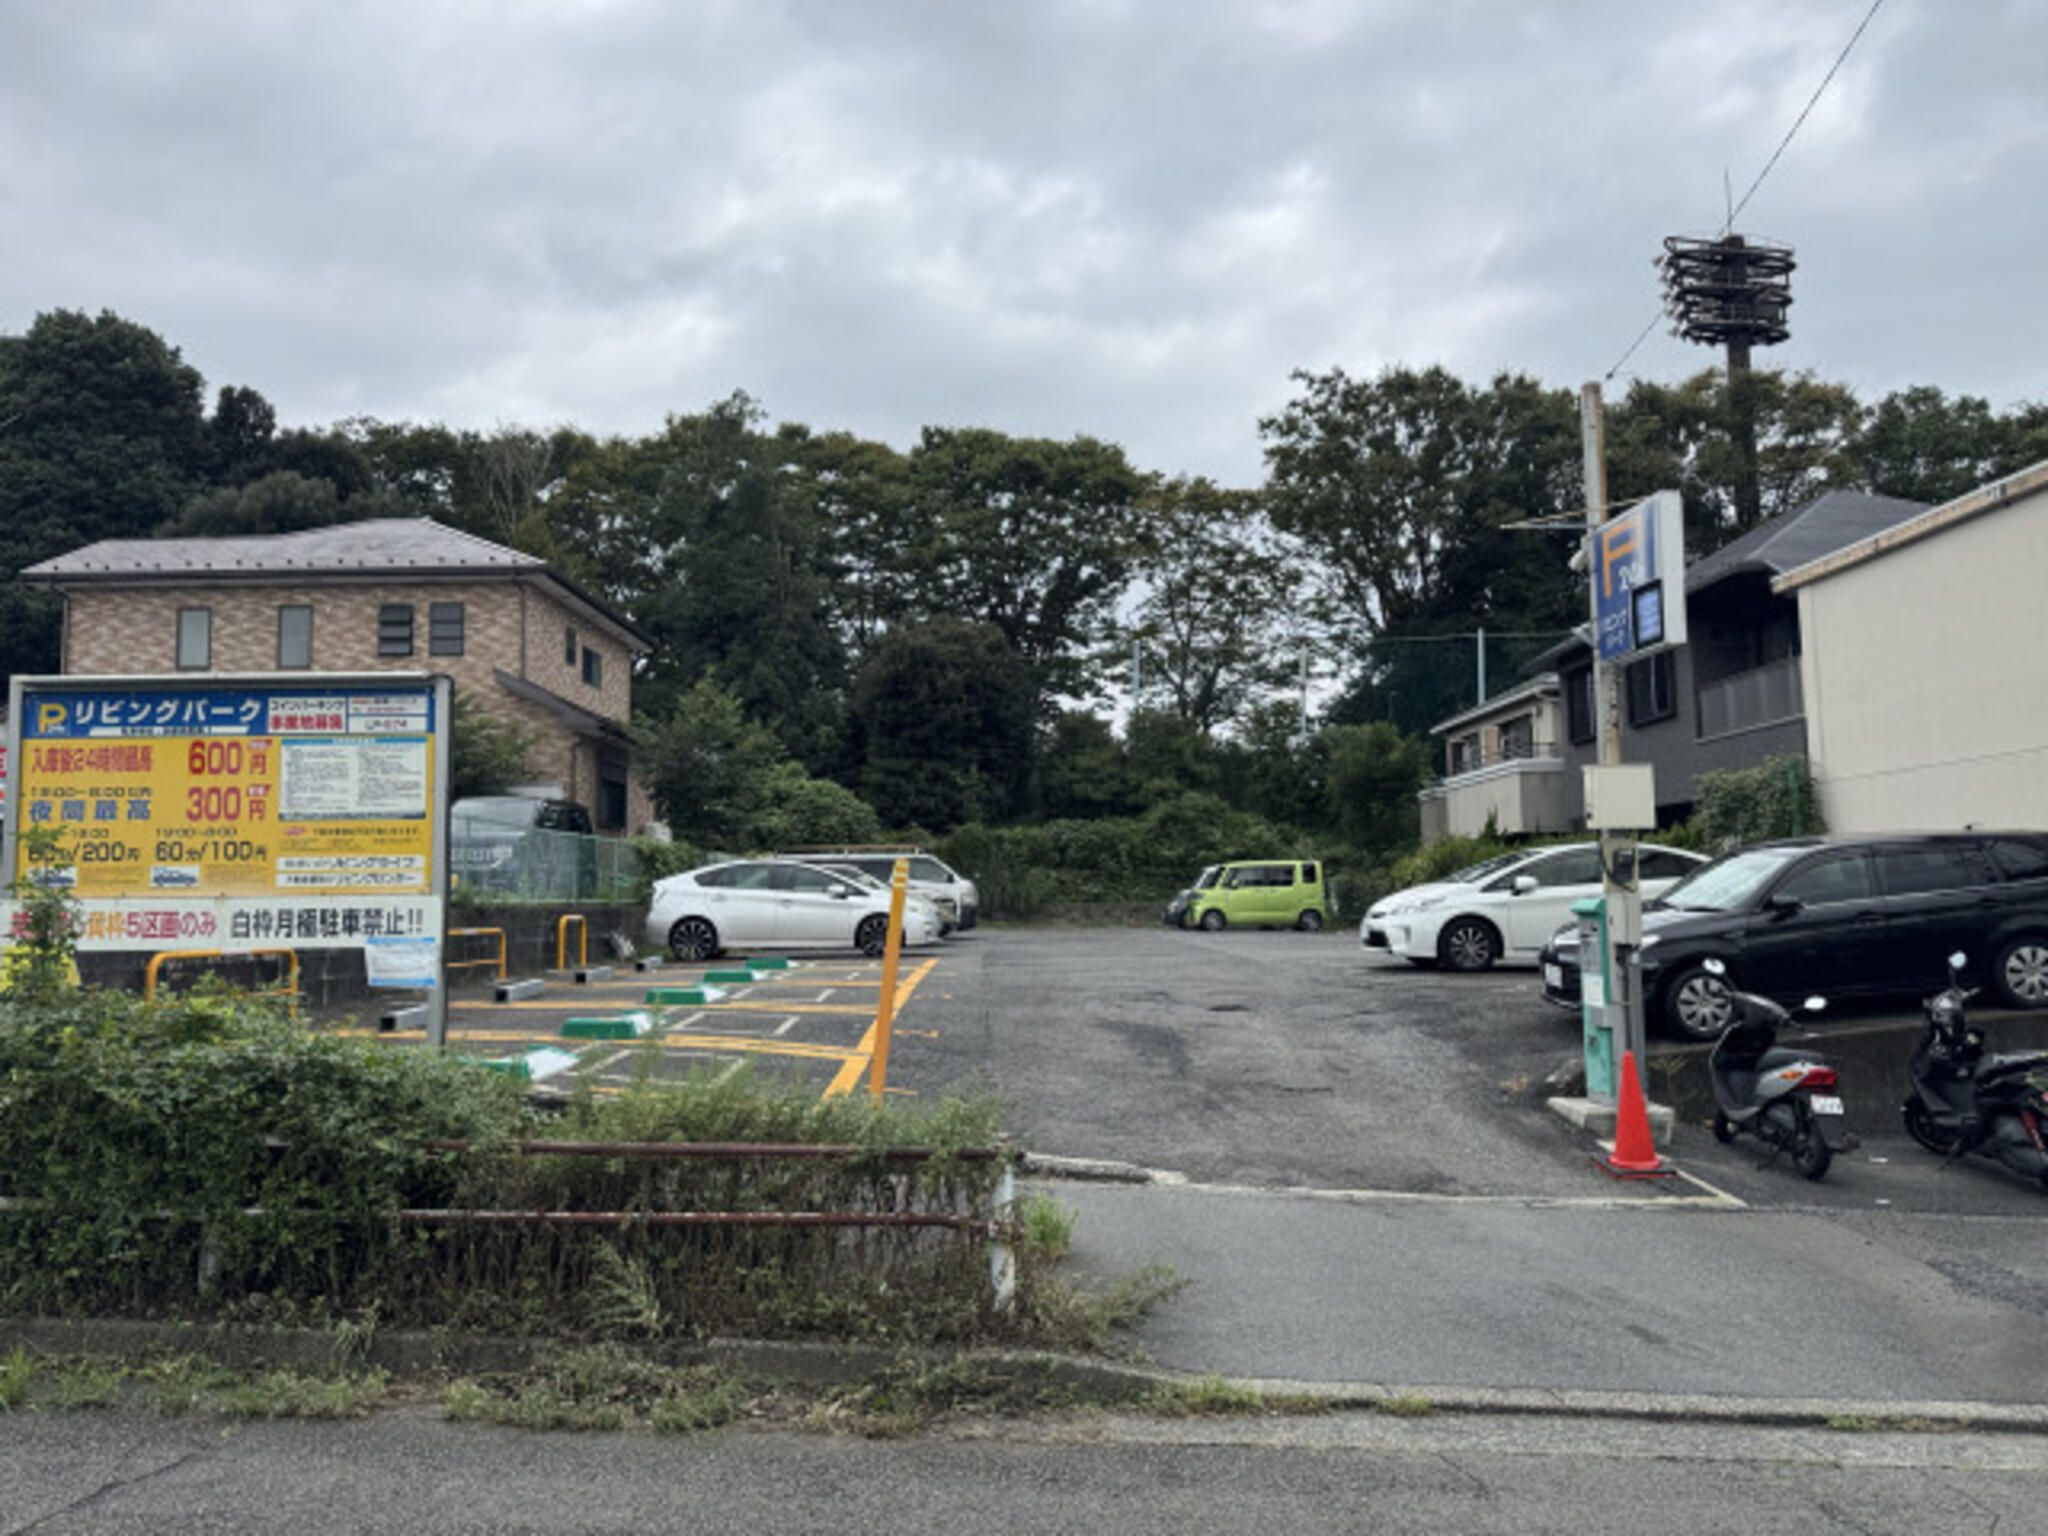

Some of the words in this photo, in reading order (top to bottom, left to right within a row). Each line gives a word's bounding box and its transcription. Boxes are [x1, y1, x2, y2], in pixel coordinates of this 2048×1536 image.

[75, 699, 261, 722] リビングパーク
[28, 799, 151, 823] 夜間最高
